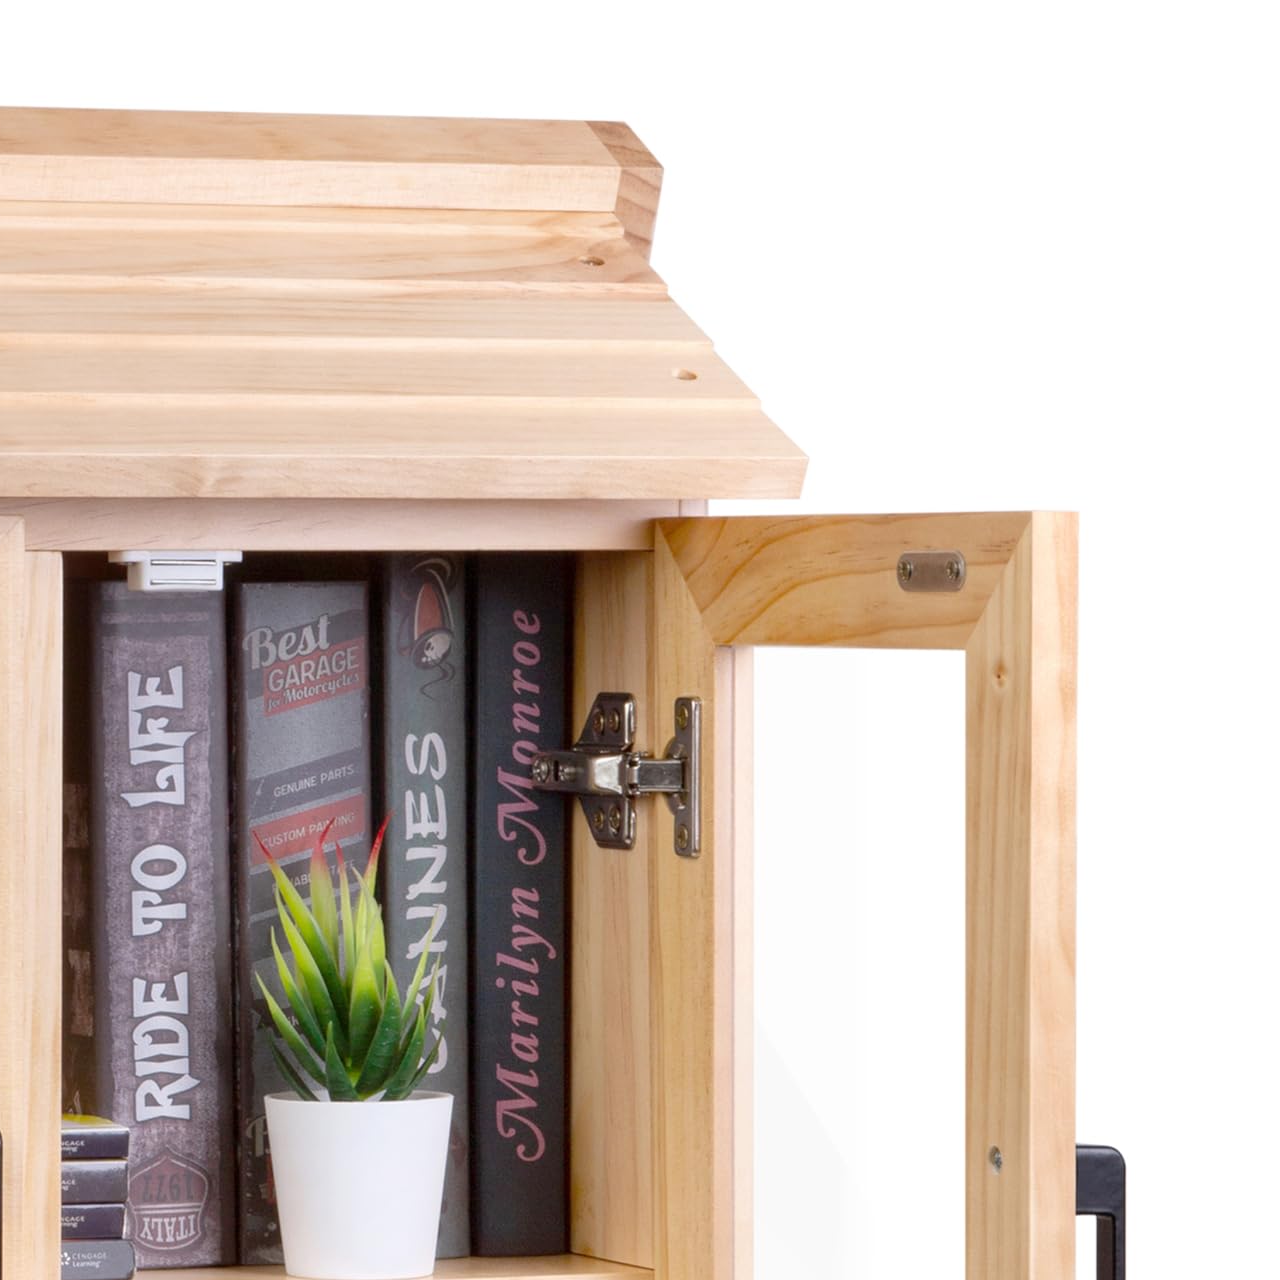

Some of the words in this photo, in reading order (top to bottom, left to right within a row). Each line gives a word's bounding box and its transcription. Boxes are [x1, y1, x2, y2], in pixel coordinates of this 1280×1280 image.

[242, 614, 330, 670] Best
[268, 646, 360, 692] GARAGE
[283, 673, 359, 702] Motorcycles
[121, 665, 201, 808] LIFE
[497, 609, 547, 865] Monroe
[273, 776, 318, 798] GENUINE
[320, 764, 355, 785] PARTS
[261, 826, 306, 849] CUSTOM
[130, 844, 187, 936] TO
[132, 971, 201, 1122] RIDE
[496, 887, 557, 1162] Marilyn
[140, 1215, 196, 1243] ITALY
